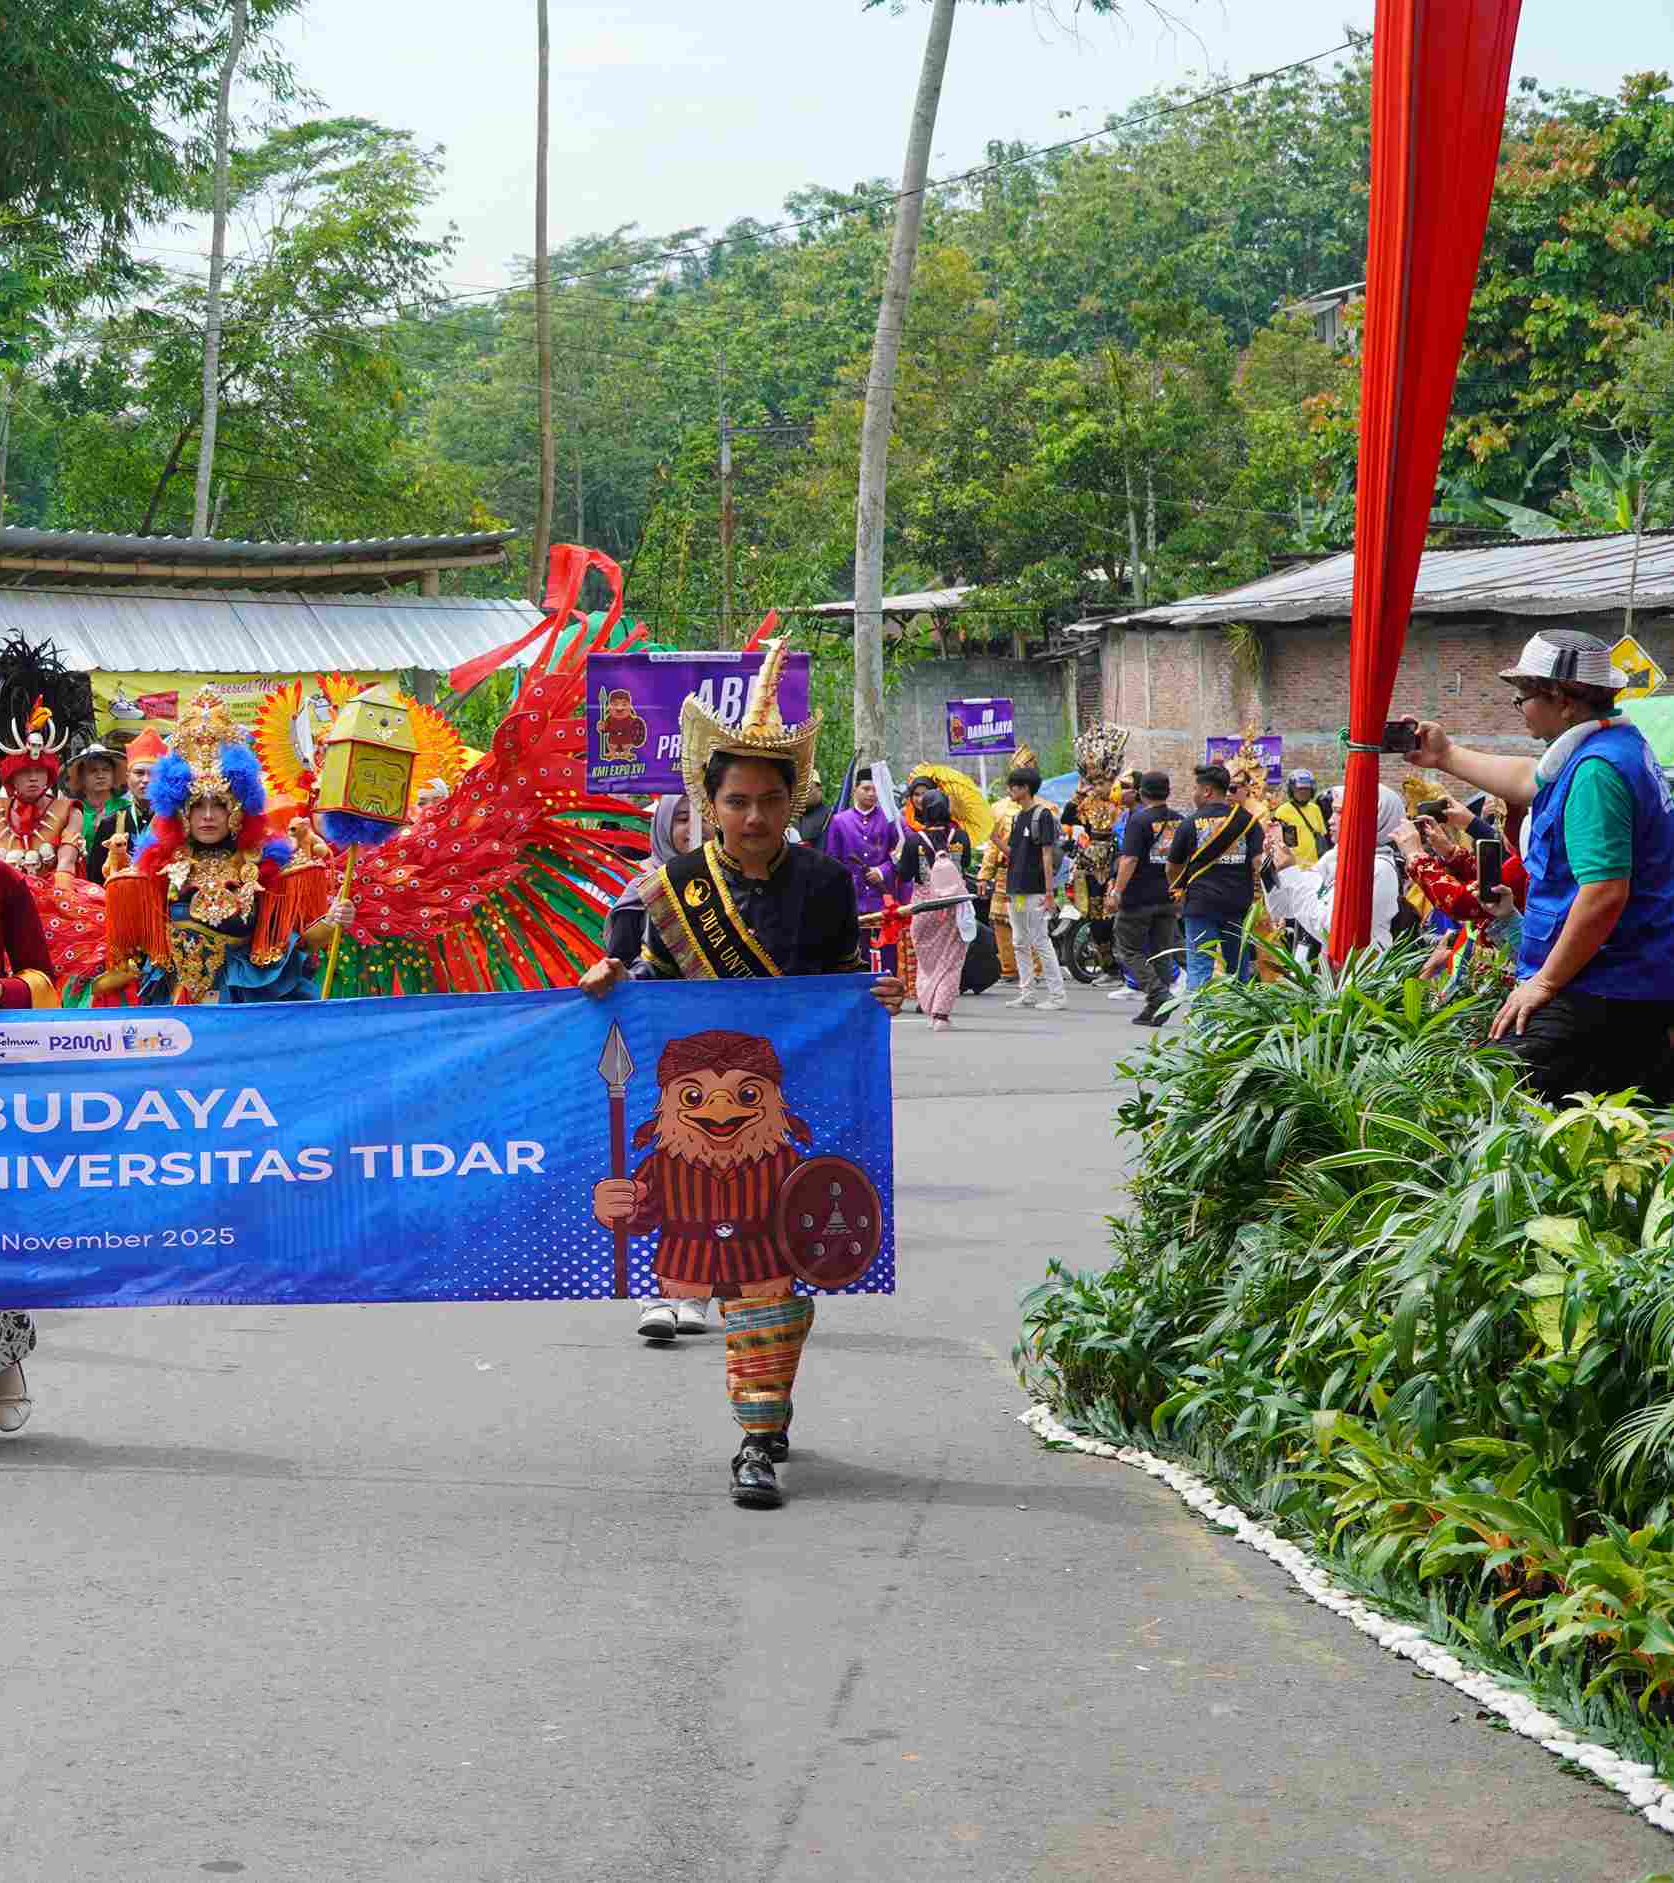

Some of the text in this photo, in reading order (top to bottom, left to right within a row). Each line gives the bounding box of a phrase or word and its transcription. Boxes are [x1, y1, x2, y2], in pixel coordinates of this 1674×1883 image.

[701, 908, 727, 949] DUTA
[350, 1140, 546, 1179] TIDAR
[2, 1231, 152, 1251] November
[163, 1227, 235, 1247] 2025
